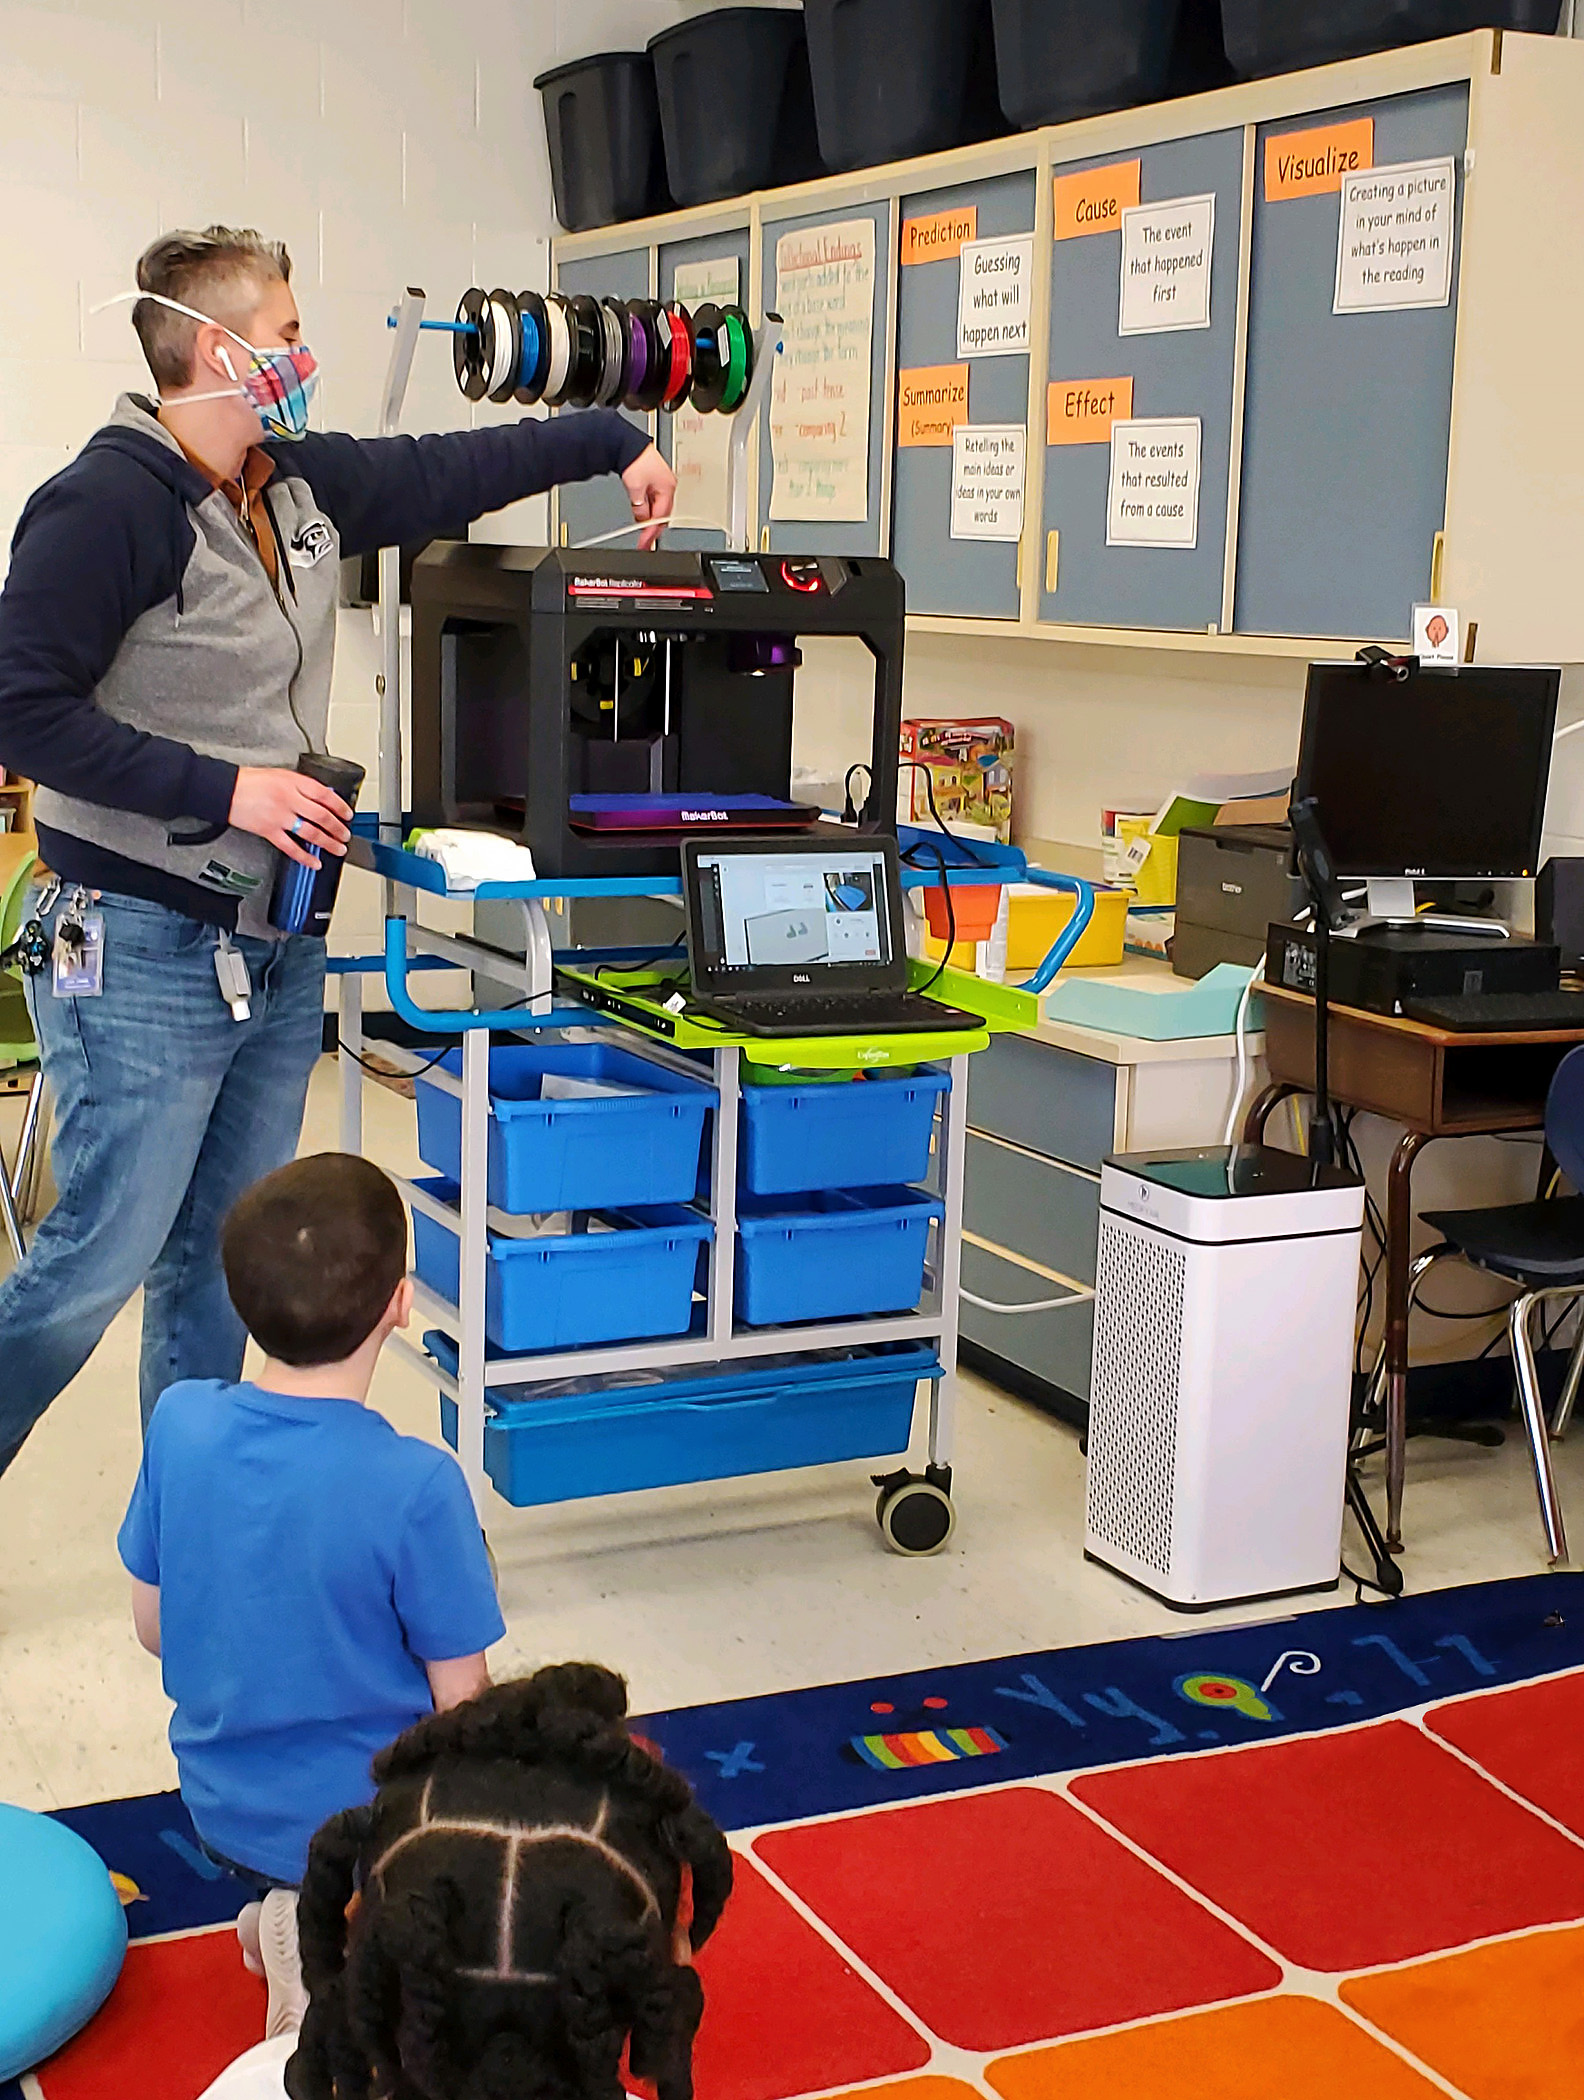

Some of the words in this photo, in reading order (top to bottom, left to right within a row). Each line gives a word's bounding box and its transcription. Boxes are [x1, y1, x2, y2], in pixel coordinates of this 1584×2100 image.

[1279, 145, 1360, 184] Visualize
[1350, 183, 1395, 203] Creating
[1397, 183, 1405, 197] a
[1407, 177, 1447, 198] picture
[1076, 198, 1117, 223] Cause
[1356, 214, 1365, 229] in
[1368, 214, 1392, 233] your
[1396, 207, 1422, 225] mind
[1425, 203, 1437, 222] of
[910, 219, 970, 249] Prediction
[1142, 227, 1162, 244] The
[1165, 222, 1192, 241] event
[1351, 240, 1385, 258] what's
[1388, 237, 1426, 257] happen
[1429, 235, 1440, 250] in
[974, 252, 1021, 276] Guessing
[1130, 258, 1152, 276] that
[1155, 248, 1204, 276] happened
[1362, 268, 1380, 285] the
[1384, 264, 1425, 284] reading
[973, 288, 998, 309] what
[1001, 284, 1019, 305] will
[1153, 284, 1177, 303] first
[963, 324, 999, 347] happen
[1002, 320, 1027, 340] next
[903, 382, 965, 407] Summarize
[1065, 390, 1115, 418] Effect
[965, 438, 999, 457] Retelling
[1001, 438, 1015, 452] the
[1128, 441, 1147, 458] The
[1150, 442, 1184, 458] events
[963, 463, 982, 476] main
[984, 461, 1004, 476] ideas
[1005, 465, 1015, 476] or
[1122, 470, 1142, 487] that
[1145, 470, 1189, 488] resulted
[956, 485, 975, 499] ideas
[977, 487, 984, 499] in
[985, 488, 1002, 503] your
[1005, 488, 1021, 499] own
[974, 509, 998, 523] words
[1120, 499, 1144, 517] from
[1147, 505, 1152, 517] a
[1155, 504, 1184, 518] cause
[681, 810, 729, 821] MakerBot
